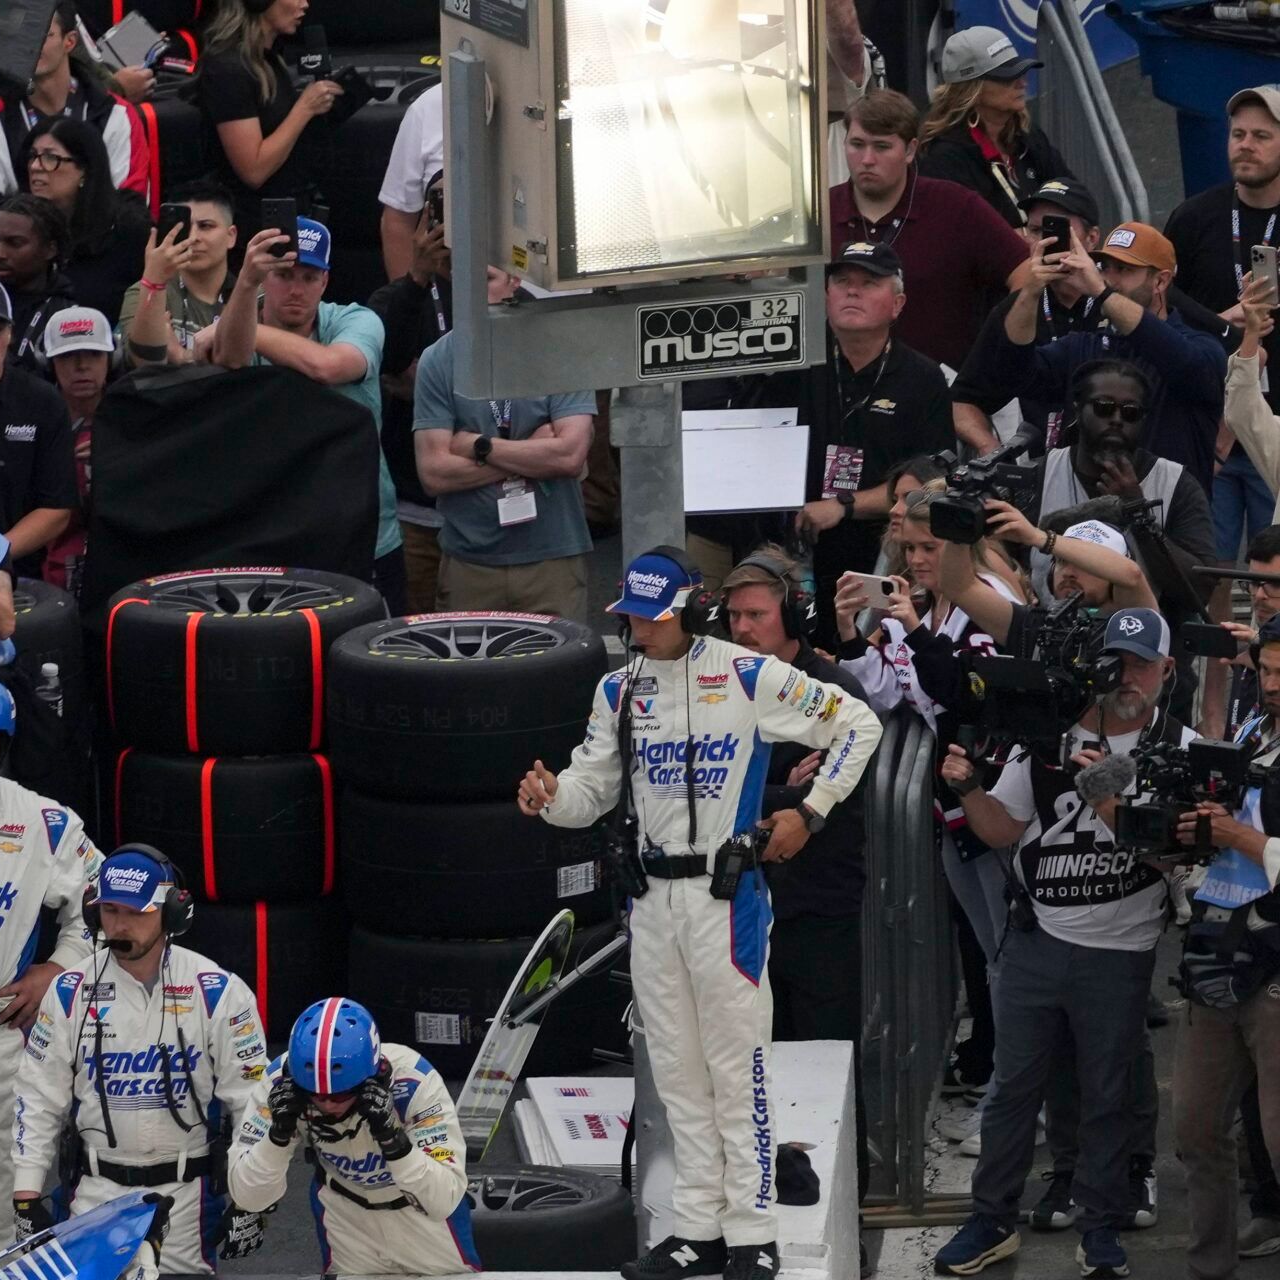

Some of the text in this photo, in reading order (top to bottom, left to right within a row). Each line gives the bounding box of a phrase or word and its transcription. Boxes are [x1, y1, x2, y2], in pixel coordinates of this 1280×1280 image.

[300, 53, 322, 65] prime
[762, 298, 788, 318] 32
[4, 423, 37, 438] Hendrick
[627, 569, 670, 588] Hendrick
[490, 611, 552, 622] REMEMBER
[696, 673, 730, 686] Hendrick
[631, 732, 740, 774] Hendrick
[104, 866, 150, 883] Hendrick
[79, 1031, 117, 1040] GOODEAR
[81, 1044, 202, 1077] Hendrick
[414, 1125, 448, 1139] SIEMENS
[755, 1046, 773, 1210] HendrickCars.com
[319, 1151, 390, 1174] endri
[671, 1244, 700, 1268] N
[757, 1249, 774, 1270] N
